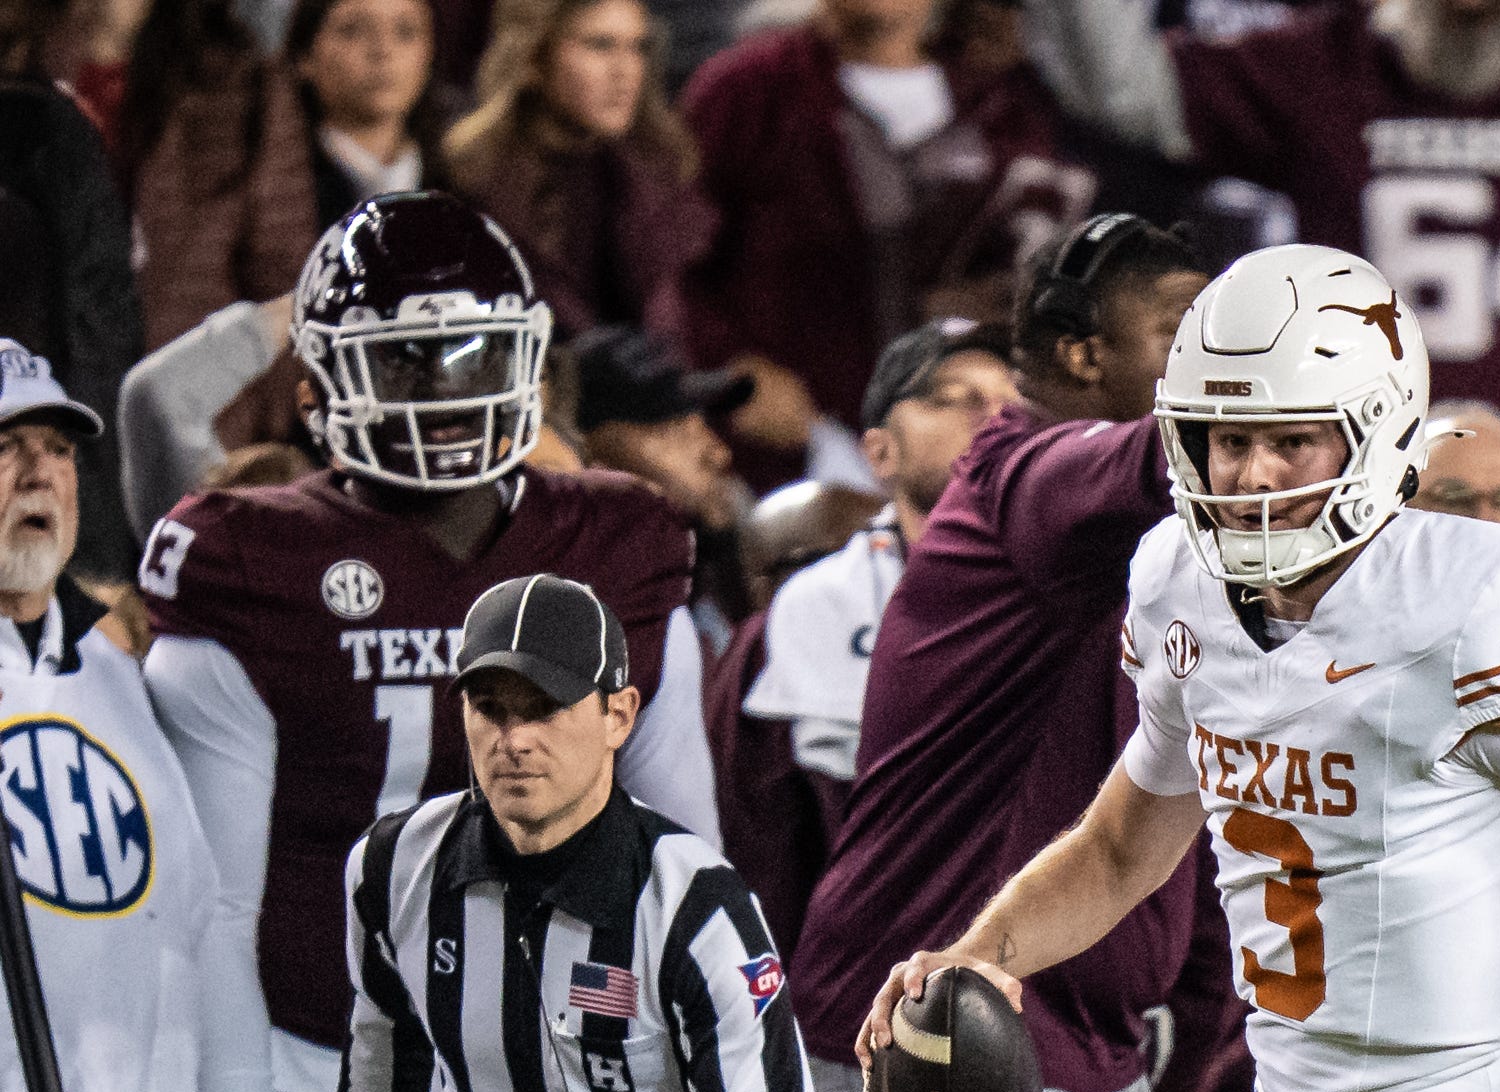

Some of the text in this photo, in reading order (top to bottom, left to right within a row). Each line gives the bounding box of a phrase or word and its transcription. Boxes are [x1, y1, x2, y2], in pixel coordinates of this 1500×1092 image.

[324, 561, 382, 617] SEC
[1165, 621, 1200, 678] SEC
[1194, 721, 1359, 818] TEXAS
[0, 727, 148, 905] SEC
[1222, 806, 1328, 1023] 3
[434, 937, 457, 975] S
[586, 1051, 631, 1092] H
